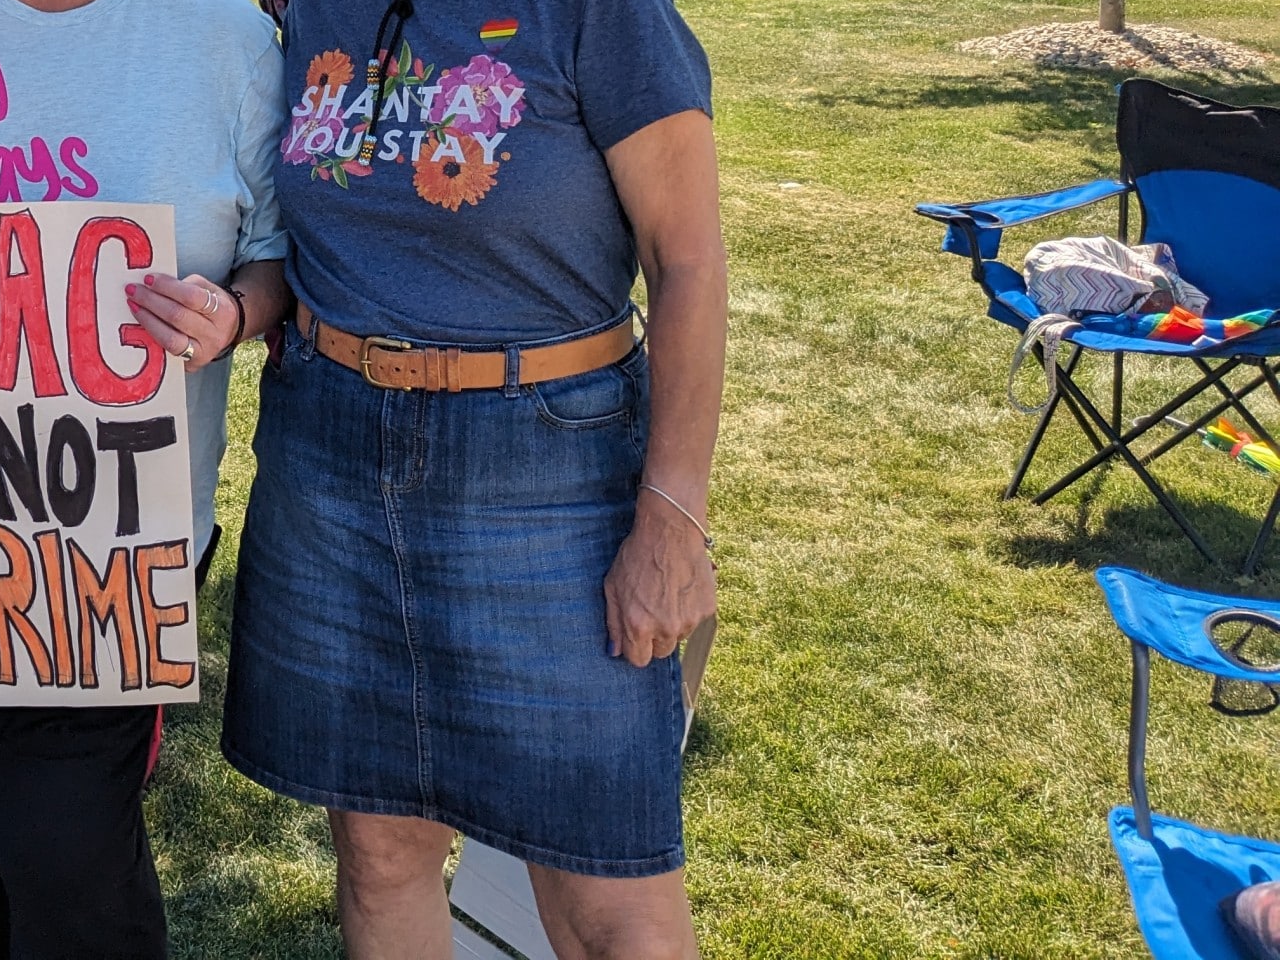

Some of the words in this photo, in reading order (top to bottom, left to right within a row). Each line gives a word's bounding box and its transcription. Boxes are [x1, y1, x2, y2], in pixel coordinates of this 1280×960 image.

[292, 85, 526, 123] SHANTAY
[286, 127, 364, 158] YOU
[377, 129, 508, 165] STAY
